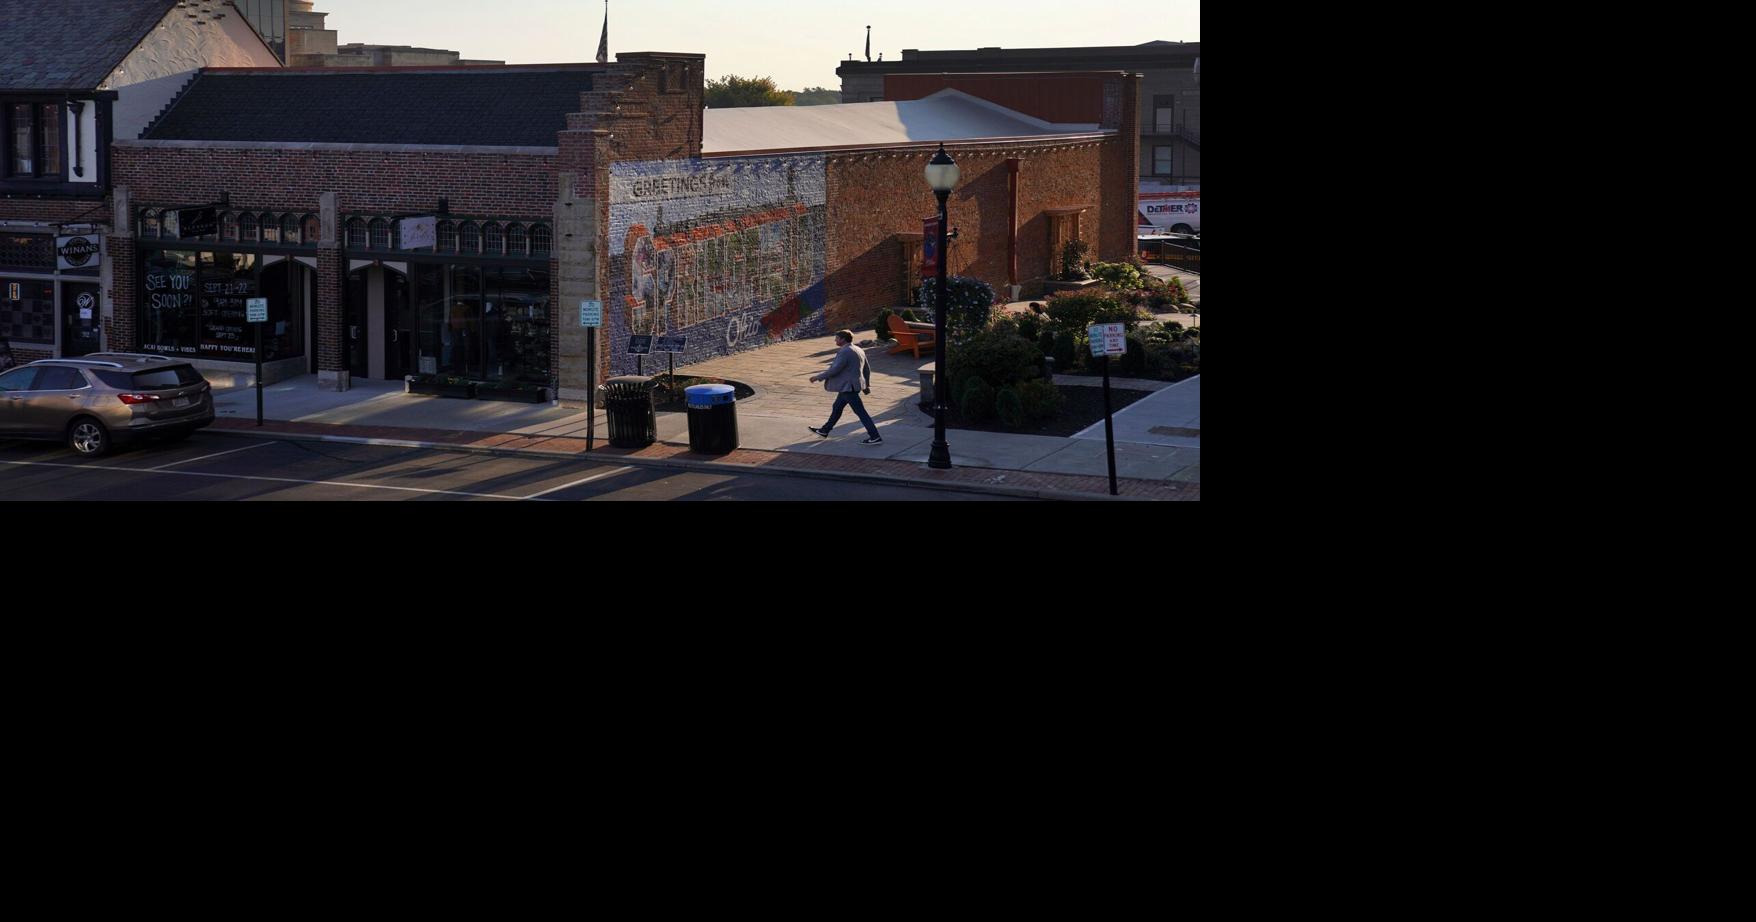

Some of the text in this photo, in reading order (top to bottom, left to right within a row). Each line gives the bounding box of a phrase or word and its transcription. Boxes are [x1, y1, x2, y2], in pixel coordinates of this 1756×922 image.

[633, 174, 705, 197] GREETINGS
[61, 244, 99, 255] WINANS
[146, 274, 189, 291] SEE YOU
[200, 343, 218, 351] HAPPY
